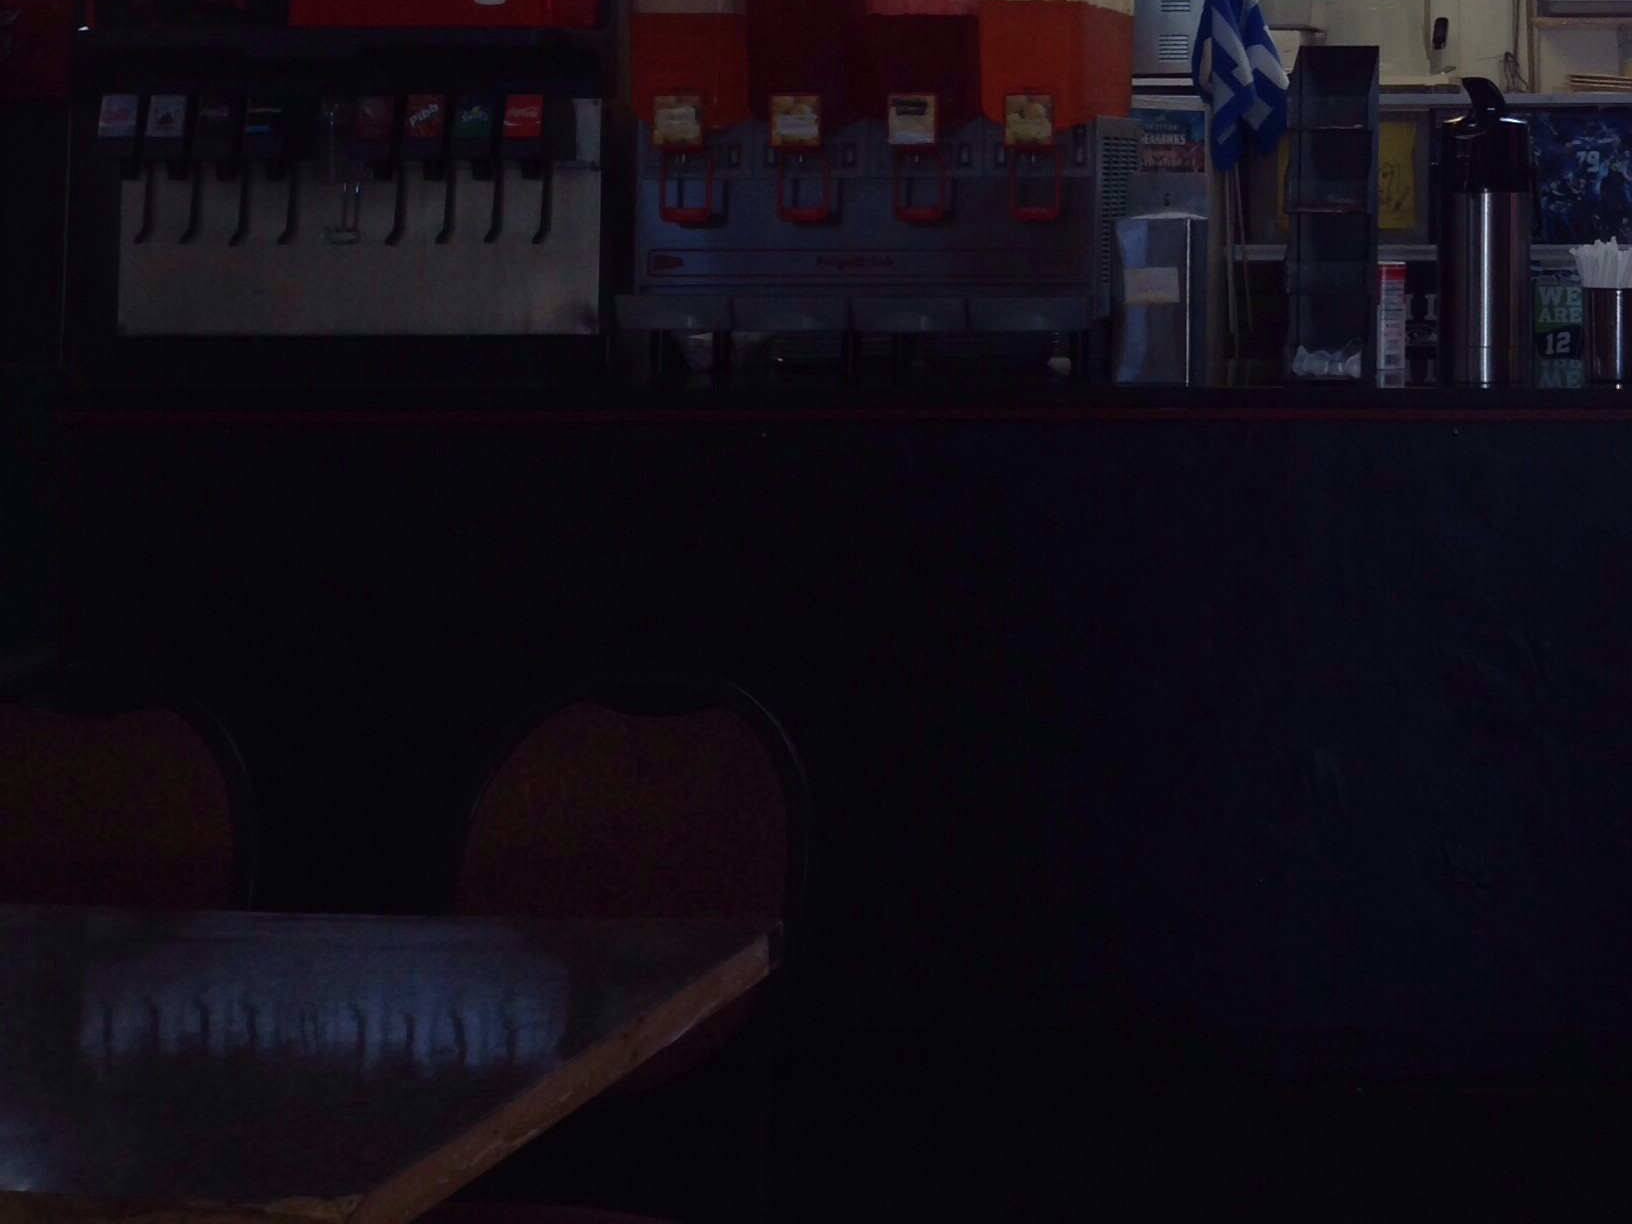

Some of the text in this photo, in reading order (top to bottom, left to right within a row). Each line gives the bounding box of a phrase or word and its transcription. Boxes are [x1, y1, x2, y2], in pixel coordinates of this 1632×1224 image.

[1537, 285, 1583, 306] WE
[1537, 307, 1583, 324] ARE
[1544, 330, 1572, 356] 12
